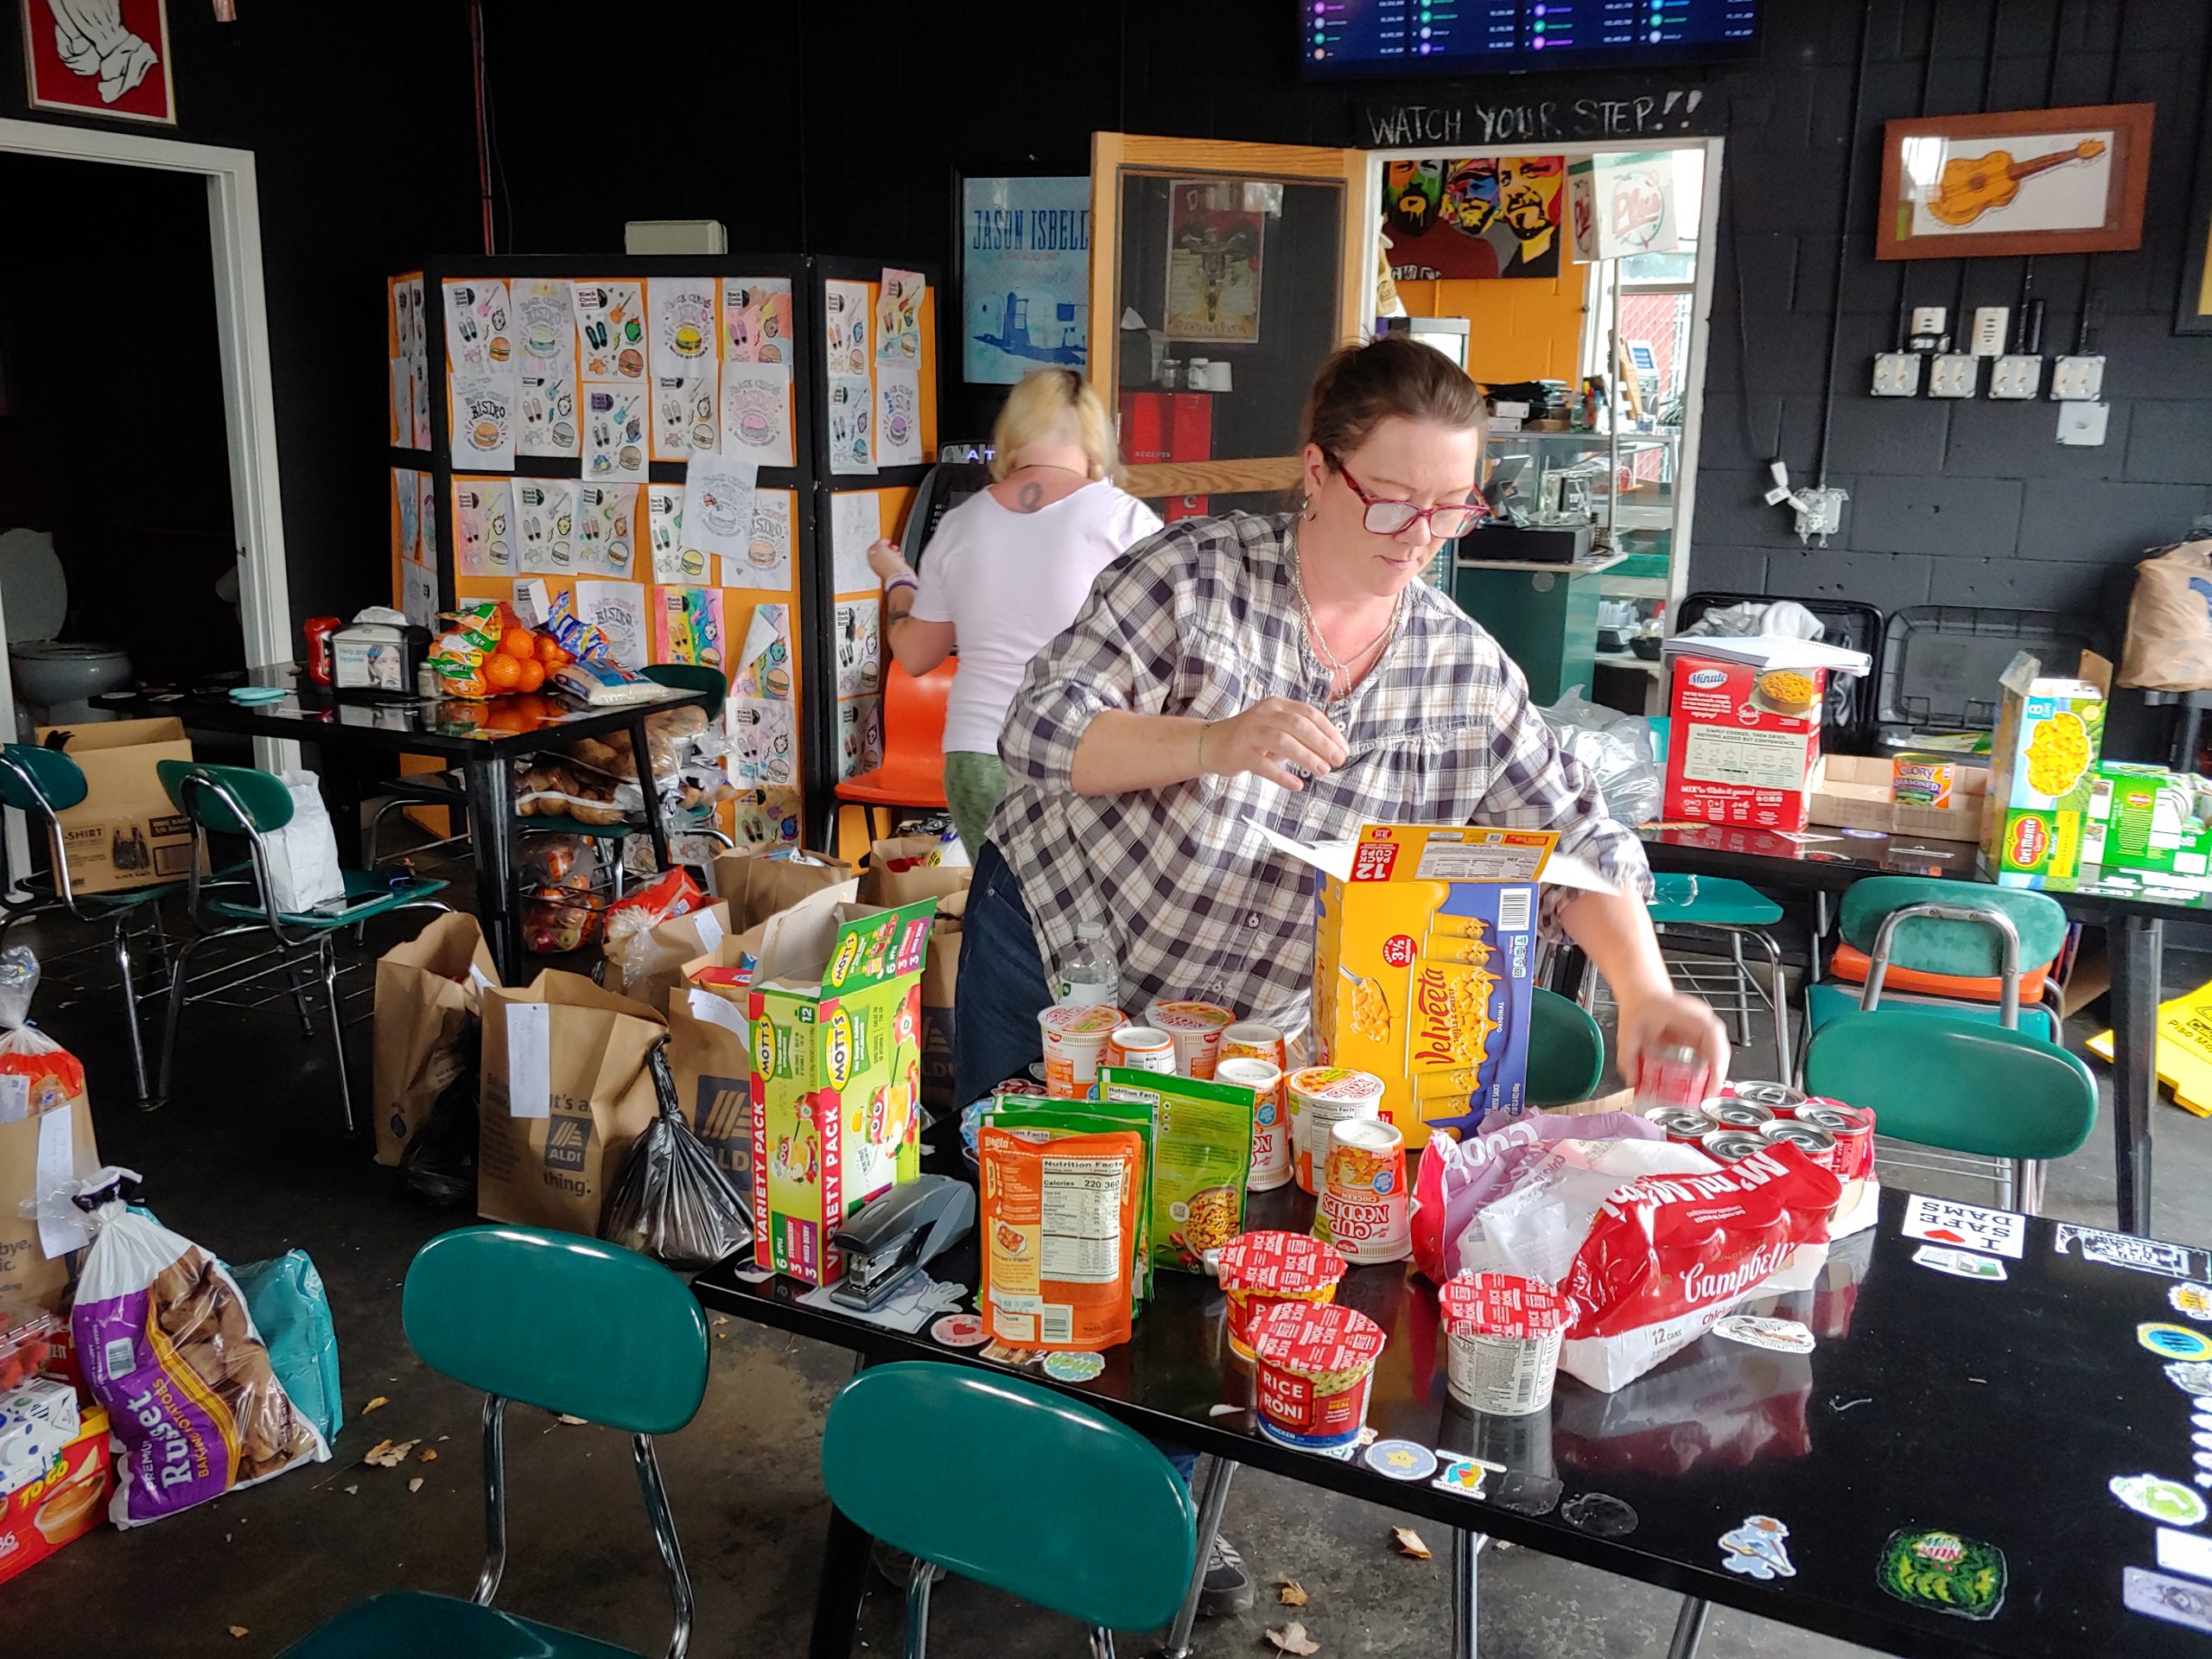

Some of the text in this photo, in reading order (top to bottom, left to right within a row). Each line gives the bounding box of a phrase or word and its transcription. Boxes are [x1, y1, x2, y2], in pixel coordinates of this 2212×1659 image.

[1367, 90, 1704, 145] WATCH YOUR STEP!!
[973, 210, 1090, 250] JASON ISBELL
[1899, 766, 1935, 779] GLORY
[1894, 778, 1941, 791] SEASONED
[64, 828, 103, 840] -SHIRT
[2018, 819, 2037, 863] Del Monte
[1356, 862, 1386, 880] 12
[836, 938, 855, 981] MOTT'S
[887, 963, 896, 974] 6
[898, 958, 907, 969] 3
[910, 954, 919, 966] 3
[802, 1007, 812, 1022] 12
[1414, 967, 1456, 1065] Velveeta
[2167, 1019, 2193, 1038] Piso
[761, 1021, 770, 1075] MOTT'S
[834, 1015, 846, 1081] MOTT'S
[1109, 1087, 1137, 1097] Nutrition
[549, 1148, 581, 1164] ALDI
[709, 1147, 750, 1171] ALD
[753, 1102, 767, 1243] VARIETY PACK
[543, 1173, 592, 1197] thing.
[825, 1106, 839, 1269] VARIETY PACK
[1084, 1179, 1102, 1188] 220
[1104, 1179, 1120, 1189] 360
[1341, 1192, 1377, 1203] CHICKEN
[1323, 1193, 1389, 1224] NOODLES
[1922, 1201, 2014, 1227] DAMS
[1329, 1216, 1372, 1240] CUP
[1920, 1212, 2011, 1238] SAFE
[1980, 1237, 2002, 1251] I
[777, 1257, 788, 1269] 6
[791, 1262, 803, 1274] 3
[804, 1267, 817, 1279] 3
[1681, 1242, 1796, 1303] Campbell'
[1651, 1327, 1666, 1346] 12
[1263, 1370, 1303, 1399] RICE
[1263, 1393, 1303, 1420] RONI
[1268, 1423, 1295, 1440] CHICKEN
[18, 1459, 70, 1509] TO GO
